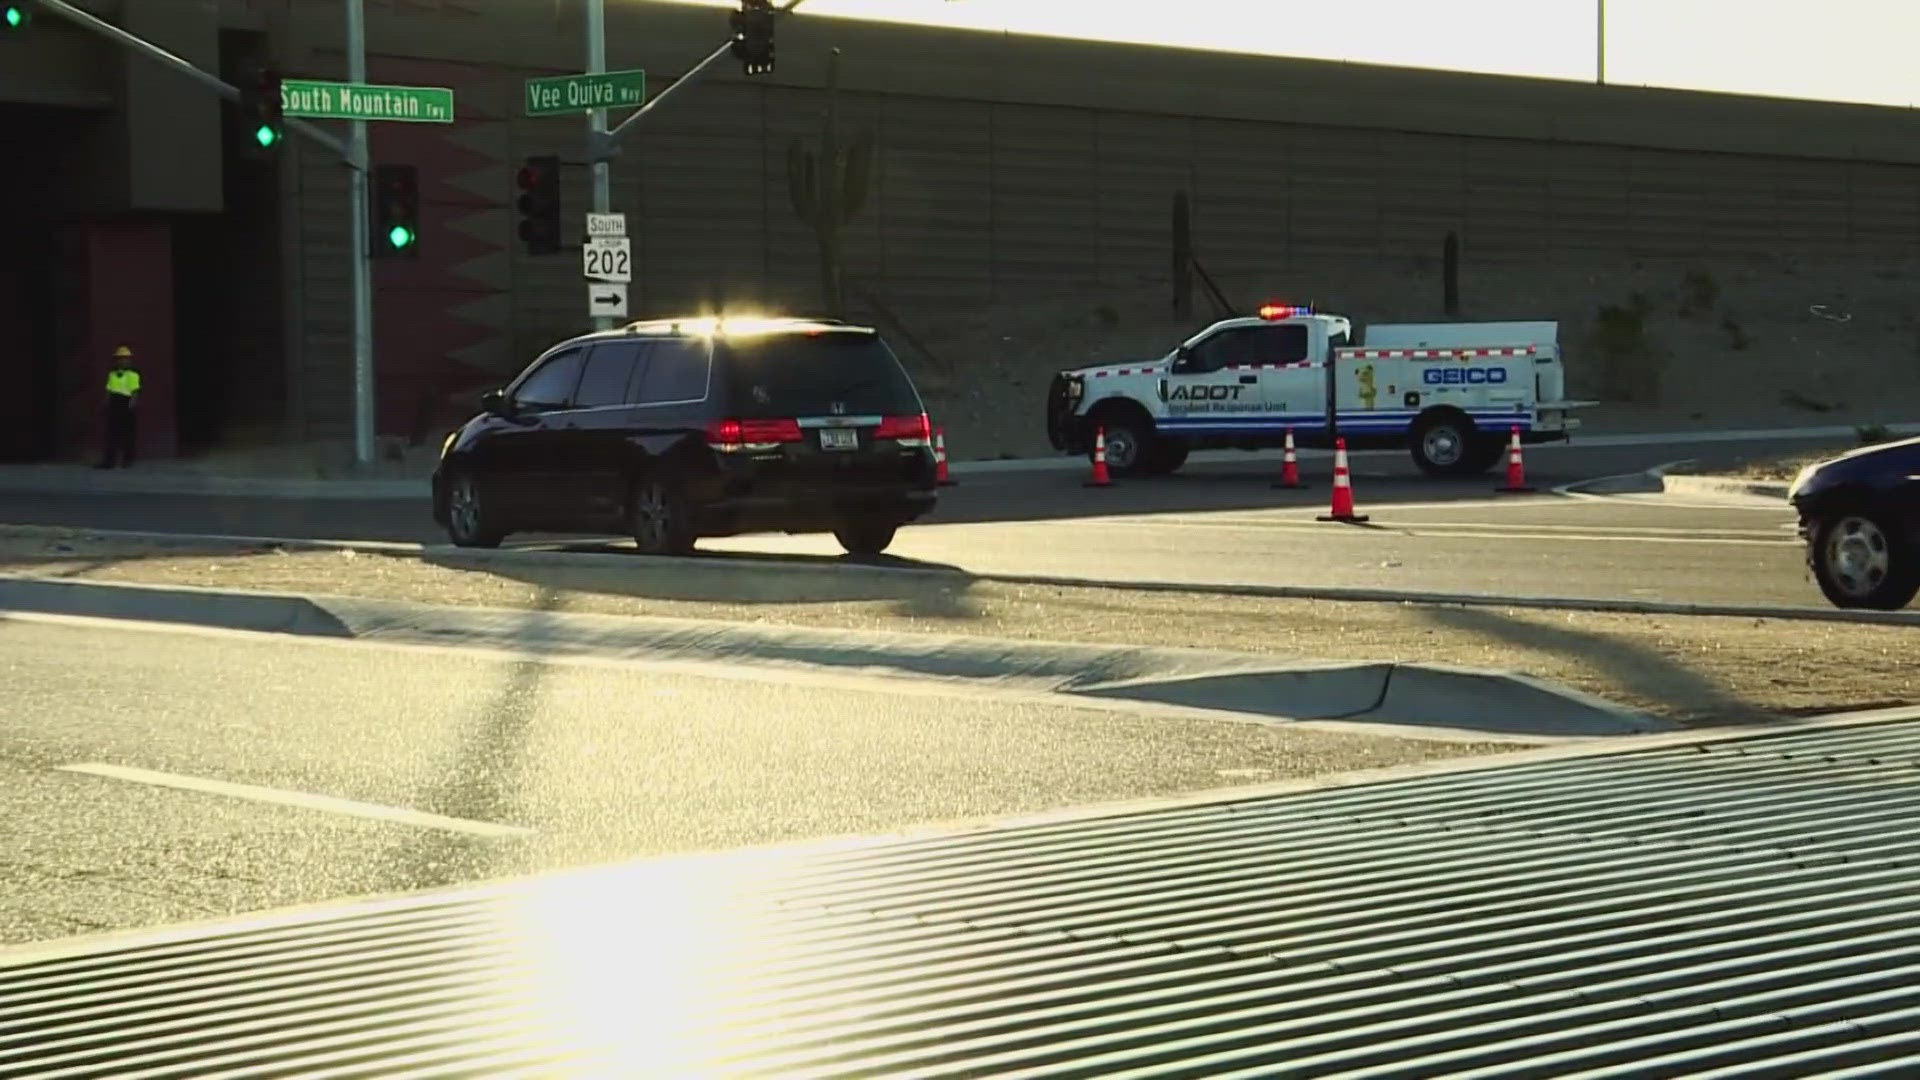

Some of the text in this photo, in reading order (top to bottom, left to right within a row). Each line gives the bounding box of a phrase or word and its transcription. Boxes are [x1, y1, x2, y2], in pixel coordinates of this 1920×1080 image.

[281, 85, 331, 112] South
[340, 88, 419, 116] Mountain
[530, 84, 561, 109] Vee
[568, 79, 613, 106] Quiva
[590, 216, 624, 232] SOUTH
[587, 250, 628, 274] 202
[1423, 367, 1507, 384] GEICO
[1171, 385, 1245, 400] ADOT
[1264, 400, 1288, 412] Unit
